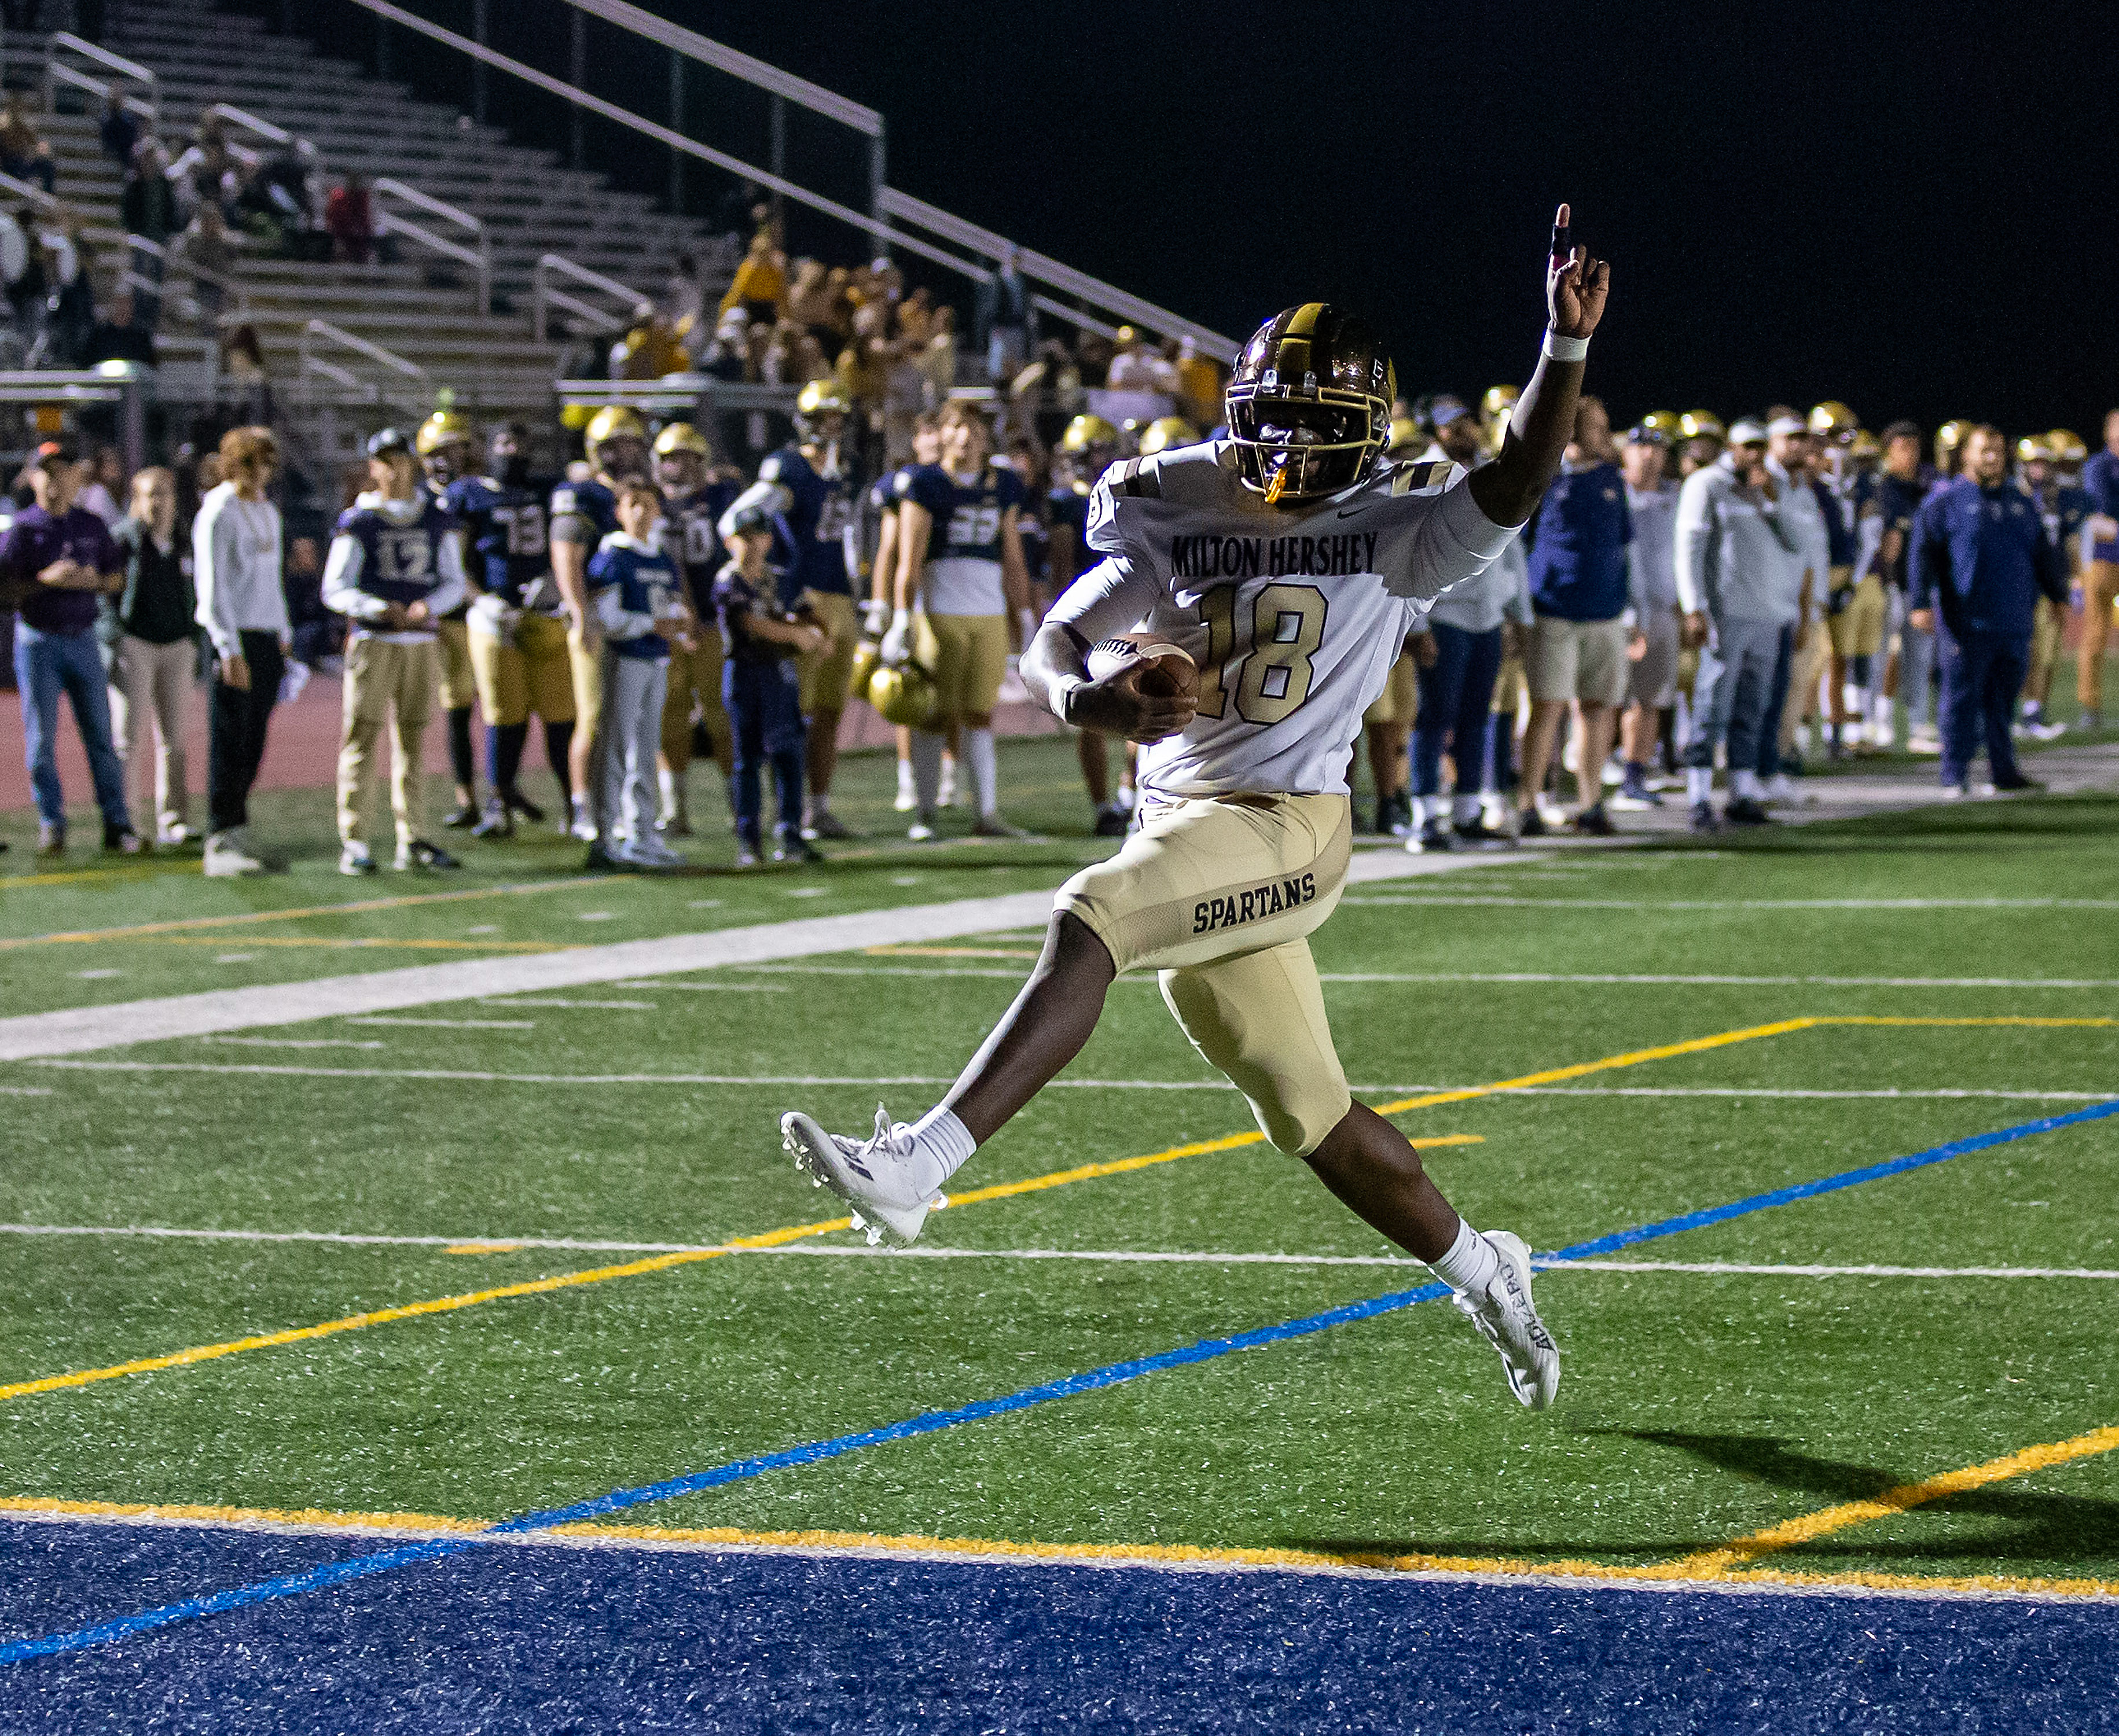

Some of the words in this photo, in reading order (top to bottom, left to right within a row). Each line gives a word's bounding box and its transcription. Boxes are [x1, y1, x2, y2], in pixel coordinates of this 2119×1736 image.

[1171, 535, 1262, 578] MILTON
[1269, 532, 1378, 577] HERSHEY
[1196, 582, 1330, 725] 18
[1193, 873, 1316, 934] SPARTANS
